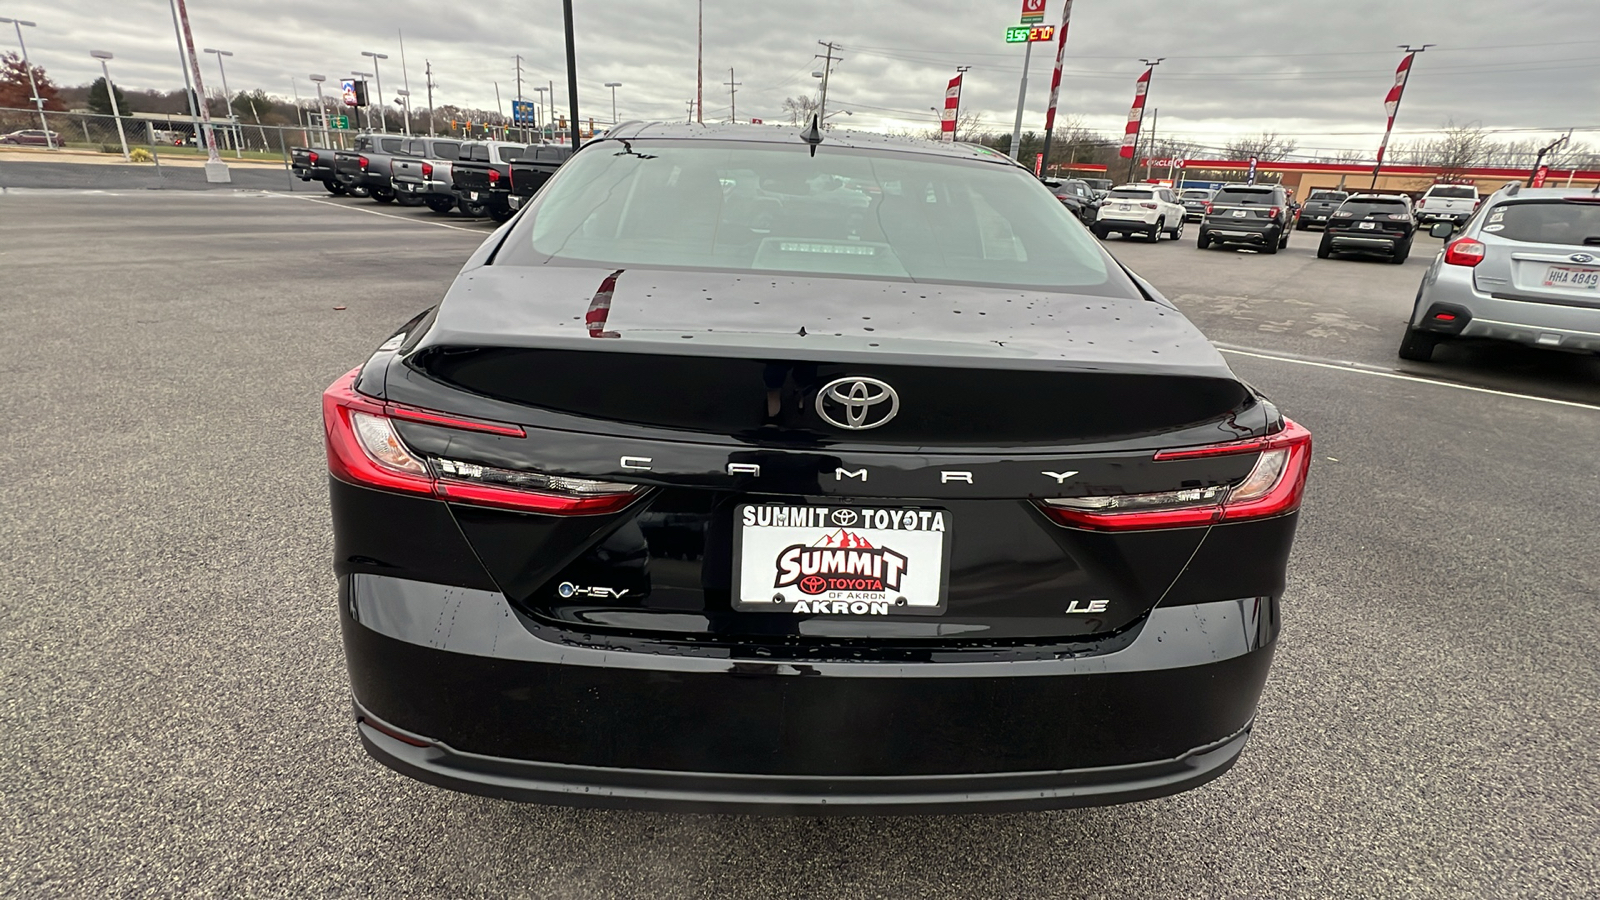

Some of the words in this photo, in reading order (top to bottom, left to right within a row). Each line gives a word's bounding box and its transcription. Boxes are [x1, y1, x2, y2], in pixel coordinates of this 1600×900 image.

[1549, 270, 1569, 283] HHA
[1571, 272, 1598, 285] 4849
[620, 456, 1079, 484] CAMRY
[742, 505, 829, 528] SUMMIT
[861, 508, 946, 532] TOYOTA
[778, 548, 905, 588] SUMMIT
[828, 578, 883, 591] TOYOTA
[828, 591, 844, 599] OF
[847, 591, 886, 600] AKRON
[792, 600, 889, 615] AKRON
[1065, 599, 1110, 614] LE
